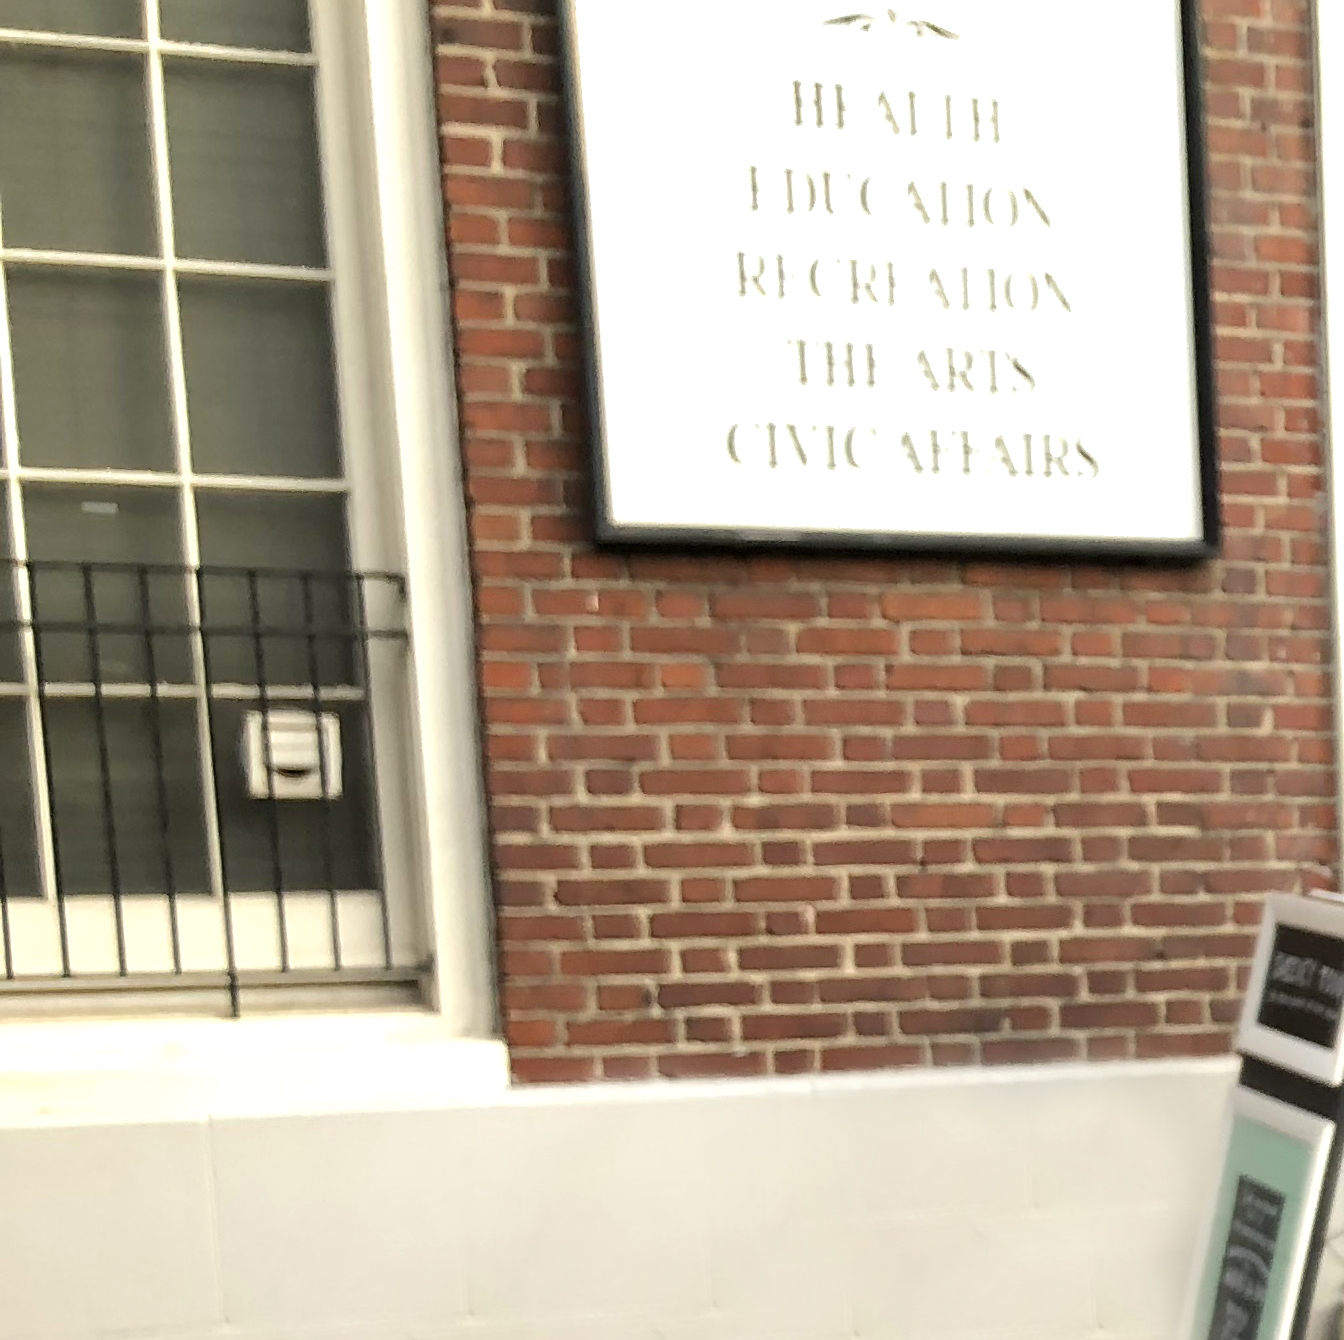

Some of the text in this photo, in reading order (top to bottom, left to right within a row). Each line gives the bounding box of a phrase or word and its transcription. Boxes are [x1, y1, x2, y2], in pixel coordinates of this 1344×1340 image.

[748, 164, 1054, 228] EDUCATION
[735, 250, 1073, 313] RECREATION
[786, 338, 1038, 395] THE ARTS
[725, 421, 1101, 478] CIVIC AFFAIRS
